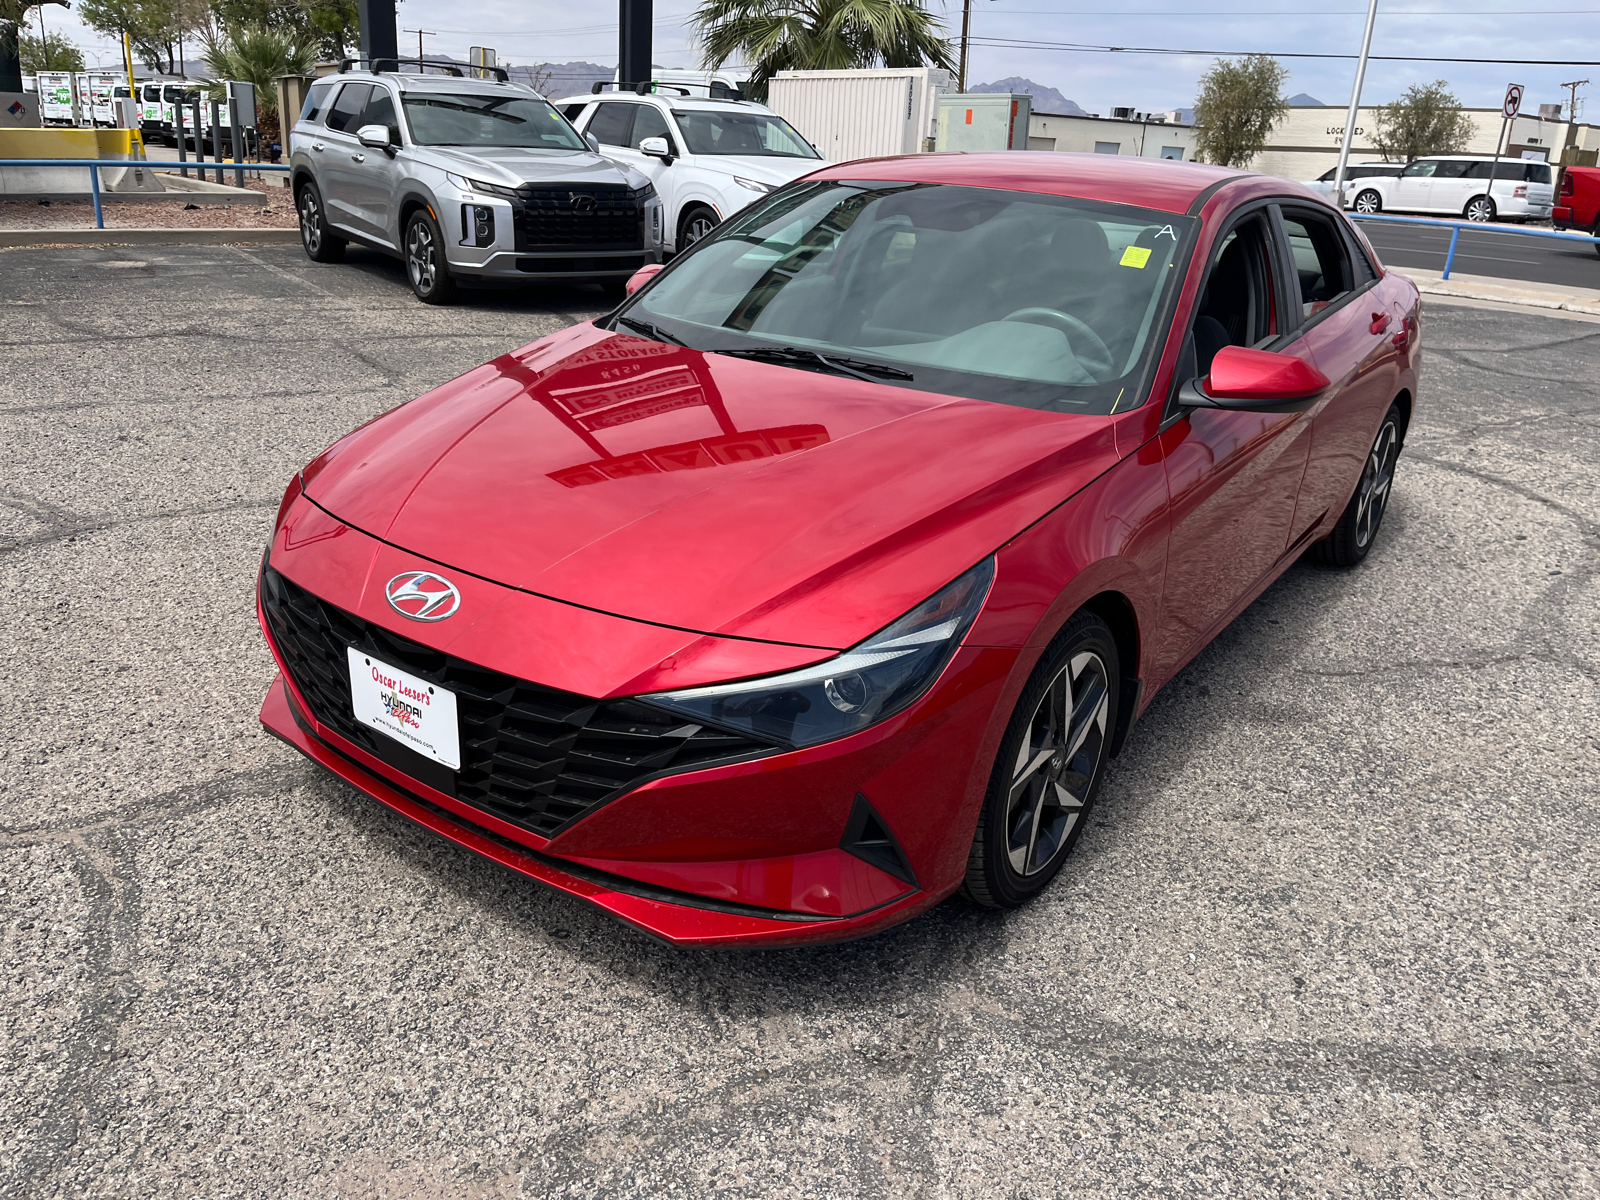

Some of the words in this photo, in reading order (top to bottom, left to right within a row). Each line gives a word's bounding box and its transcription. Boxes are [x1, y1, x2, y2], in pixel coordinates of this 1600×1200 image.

[1326, 127, 1364, 136] LOCKED
[1154, 224, 1177, 241] A
[371, 666, 397, 690] Oscar
[398, 680, 431, 706] Leeser's
[380, 691, 423, 719] HYUNDAI
